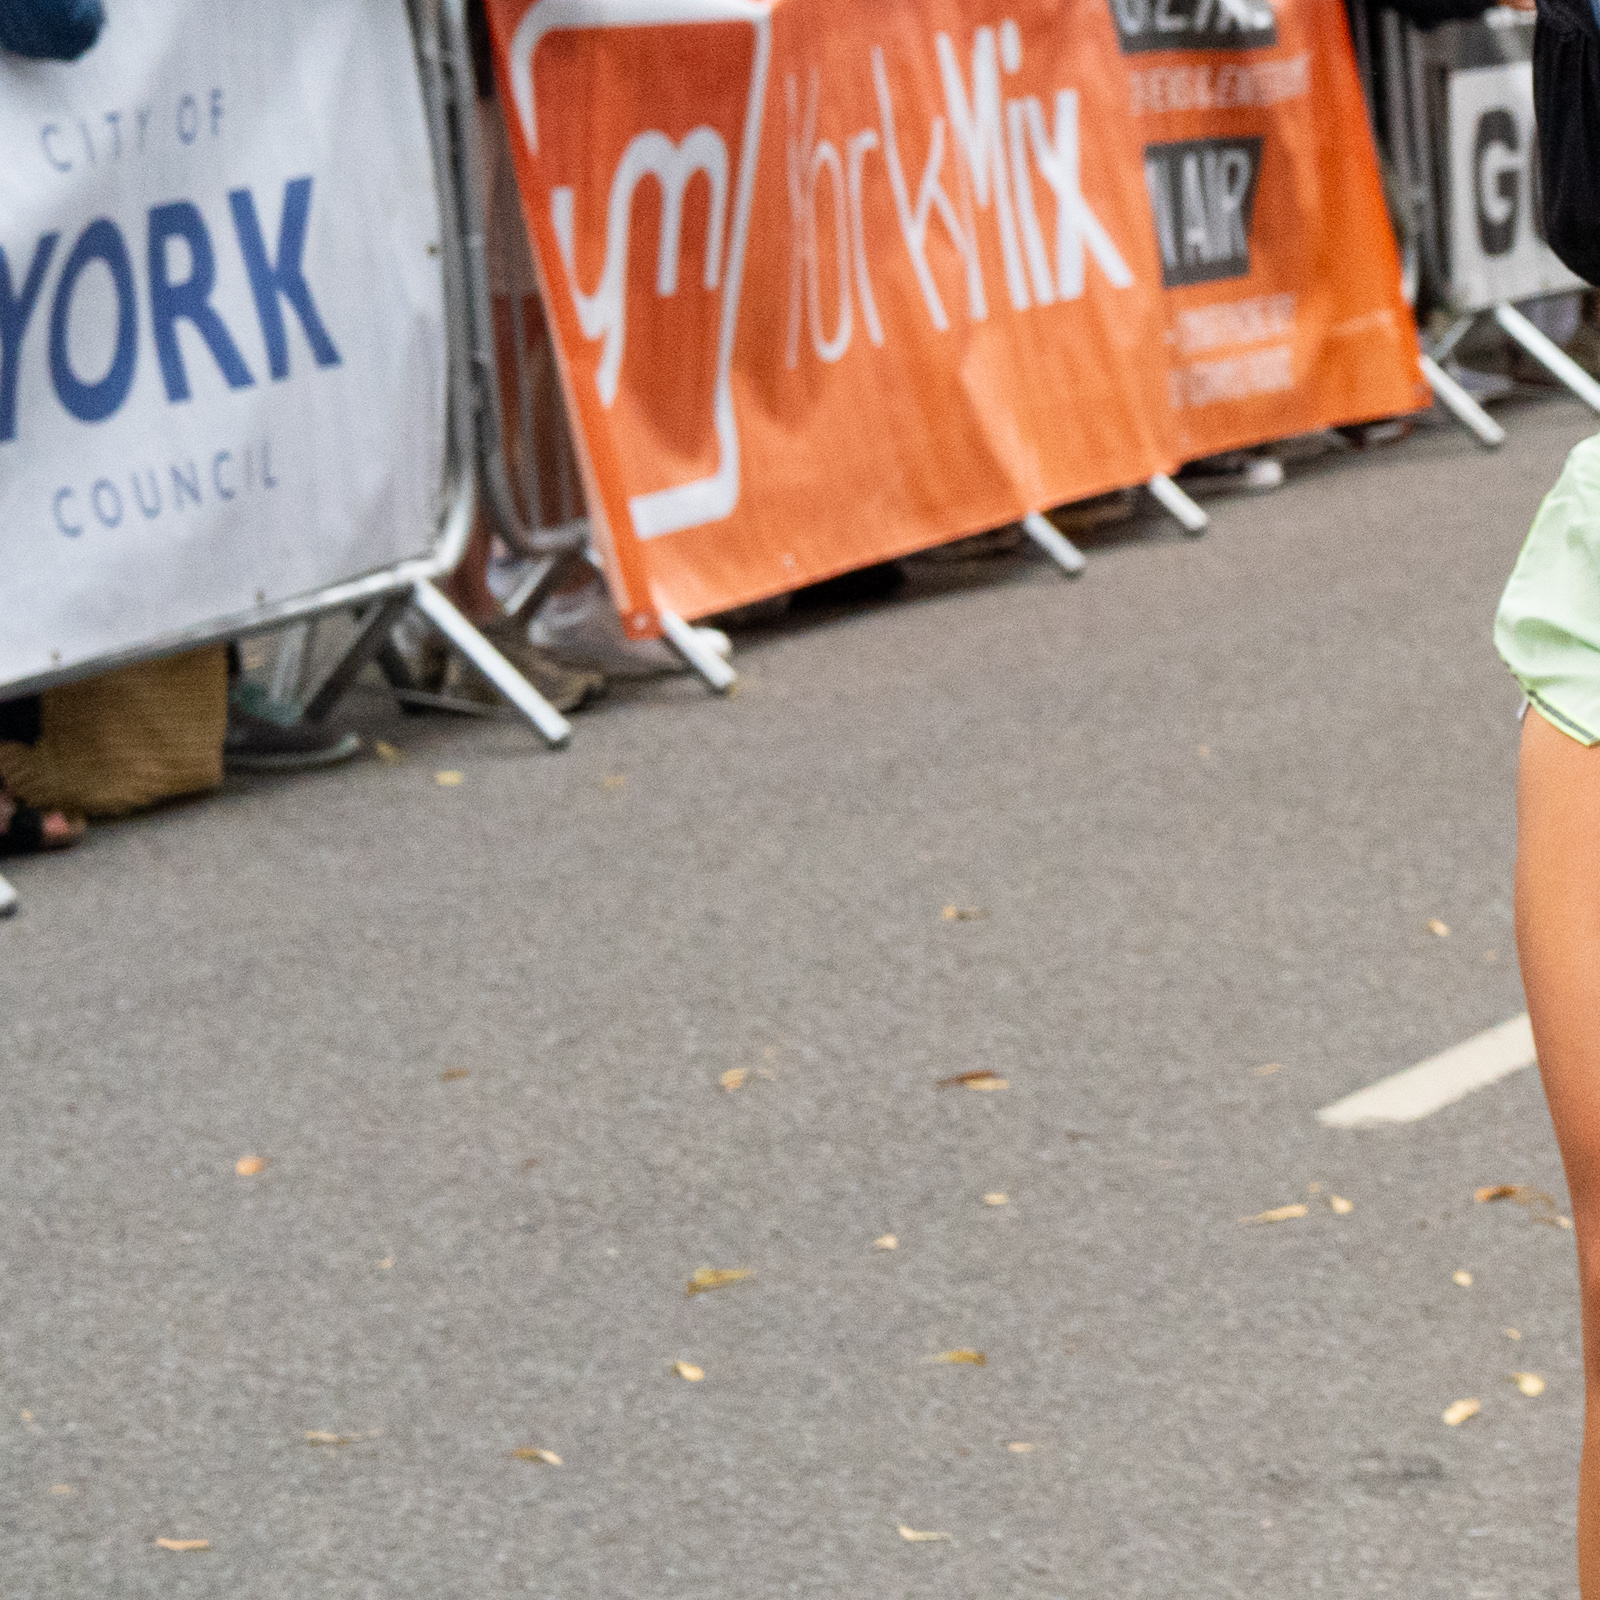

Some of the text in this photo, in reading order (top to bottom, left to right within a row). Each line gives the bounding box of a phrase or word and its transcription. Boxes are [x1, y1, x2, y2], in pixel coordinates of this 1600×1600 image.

[40, 87, 228, 172] CITY OF
[0, 175, 343, 443] YORK
[53, 438, 279, 538] COUNCIL
